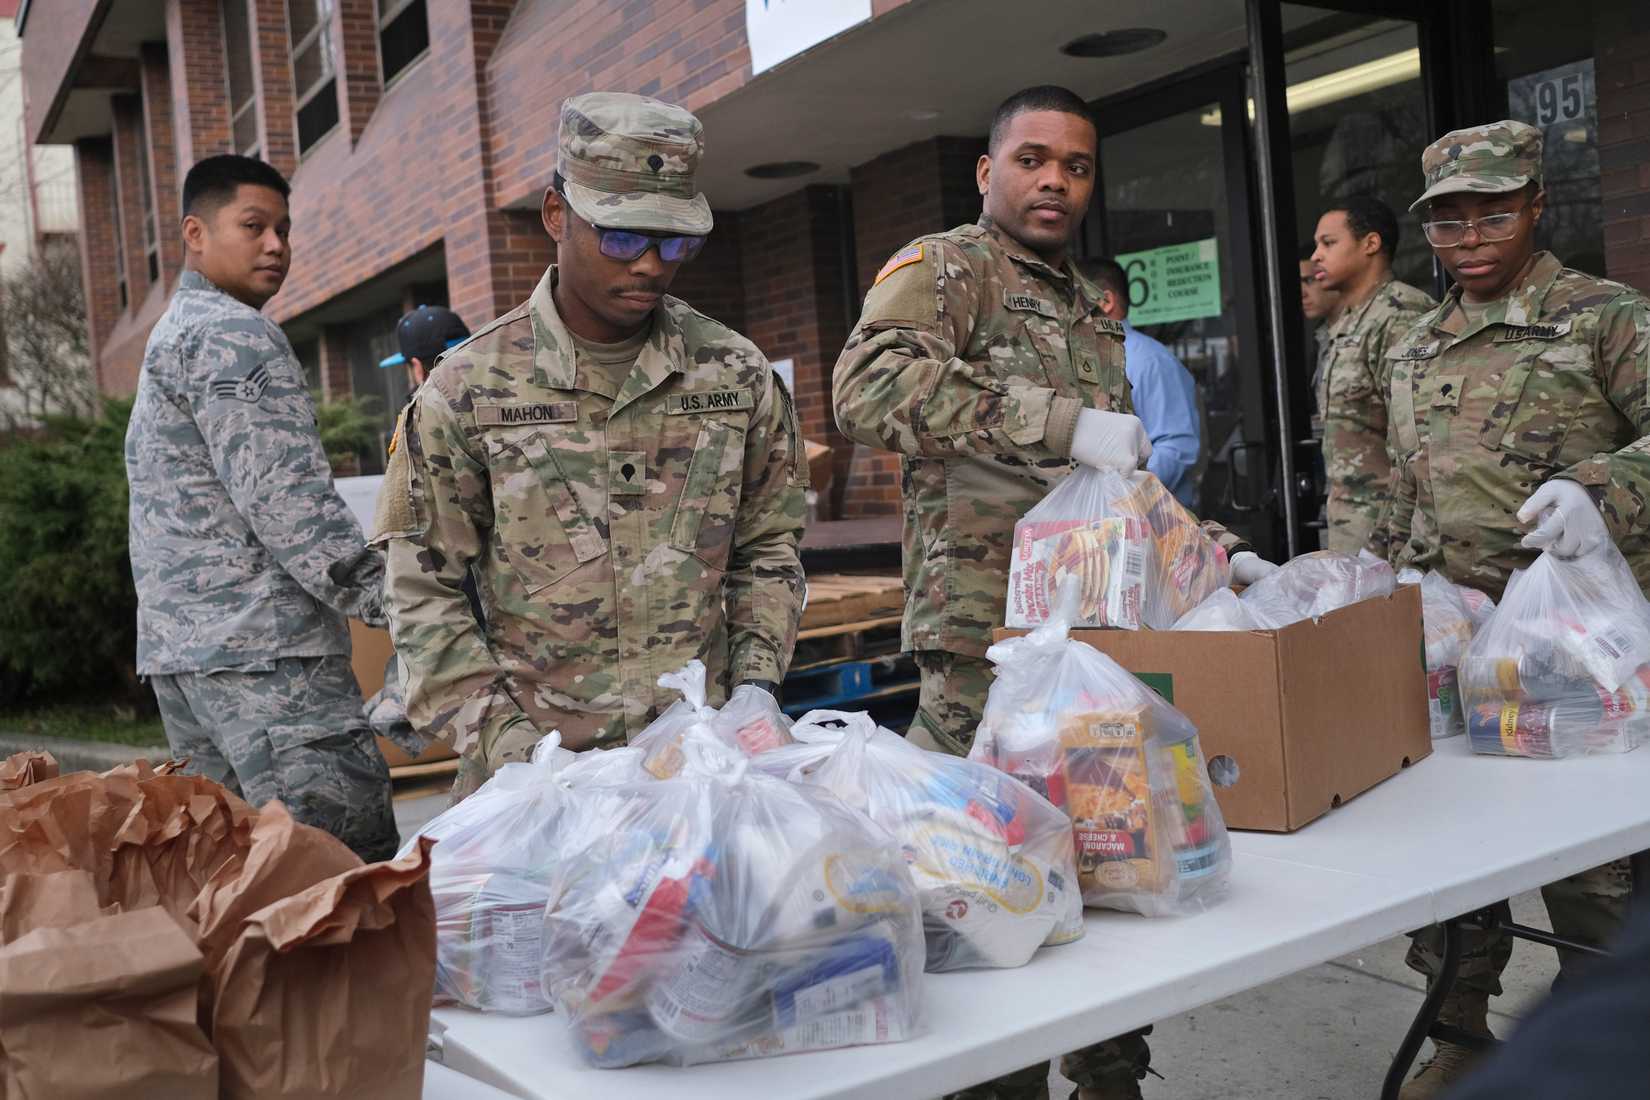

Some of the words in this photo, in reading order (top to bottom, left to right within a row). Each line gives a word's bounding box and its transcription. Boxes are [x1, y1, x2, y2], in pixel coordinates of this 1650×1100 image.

[1539, 76, 1581, 125] 95
[1166, 262, 1209, 276] INSURANCE
[1126, 258, 1149, 308] 6
[1167, 273, 1212, 287] REDUCTION
[1012, 296, 1041, 312] HENRY
[681, 398, 702, 411] U.S.
[707, 392, 740, 408] ARMY
[501, 405, 553, 422] MAHON
[1023, 561, 1035, 582] Mix
[1506, 708, 1517, 737] Kidney
[1078, 832, 1107, 842] CHEESE
[1110, 833, 1117, 842] &
[1082, 841, 1125, 850] MACARONI
